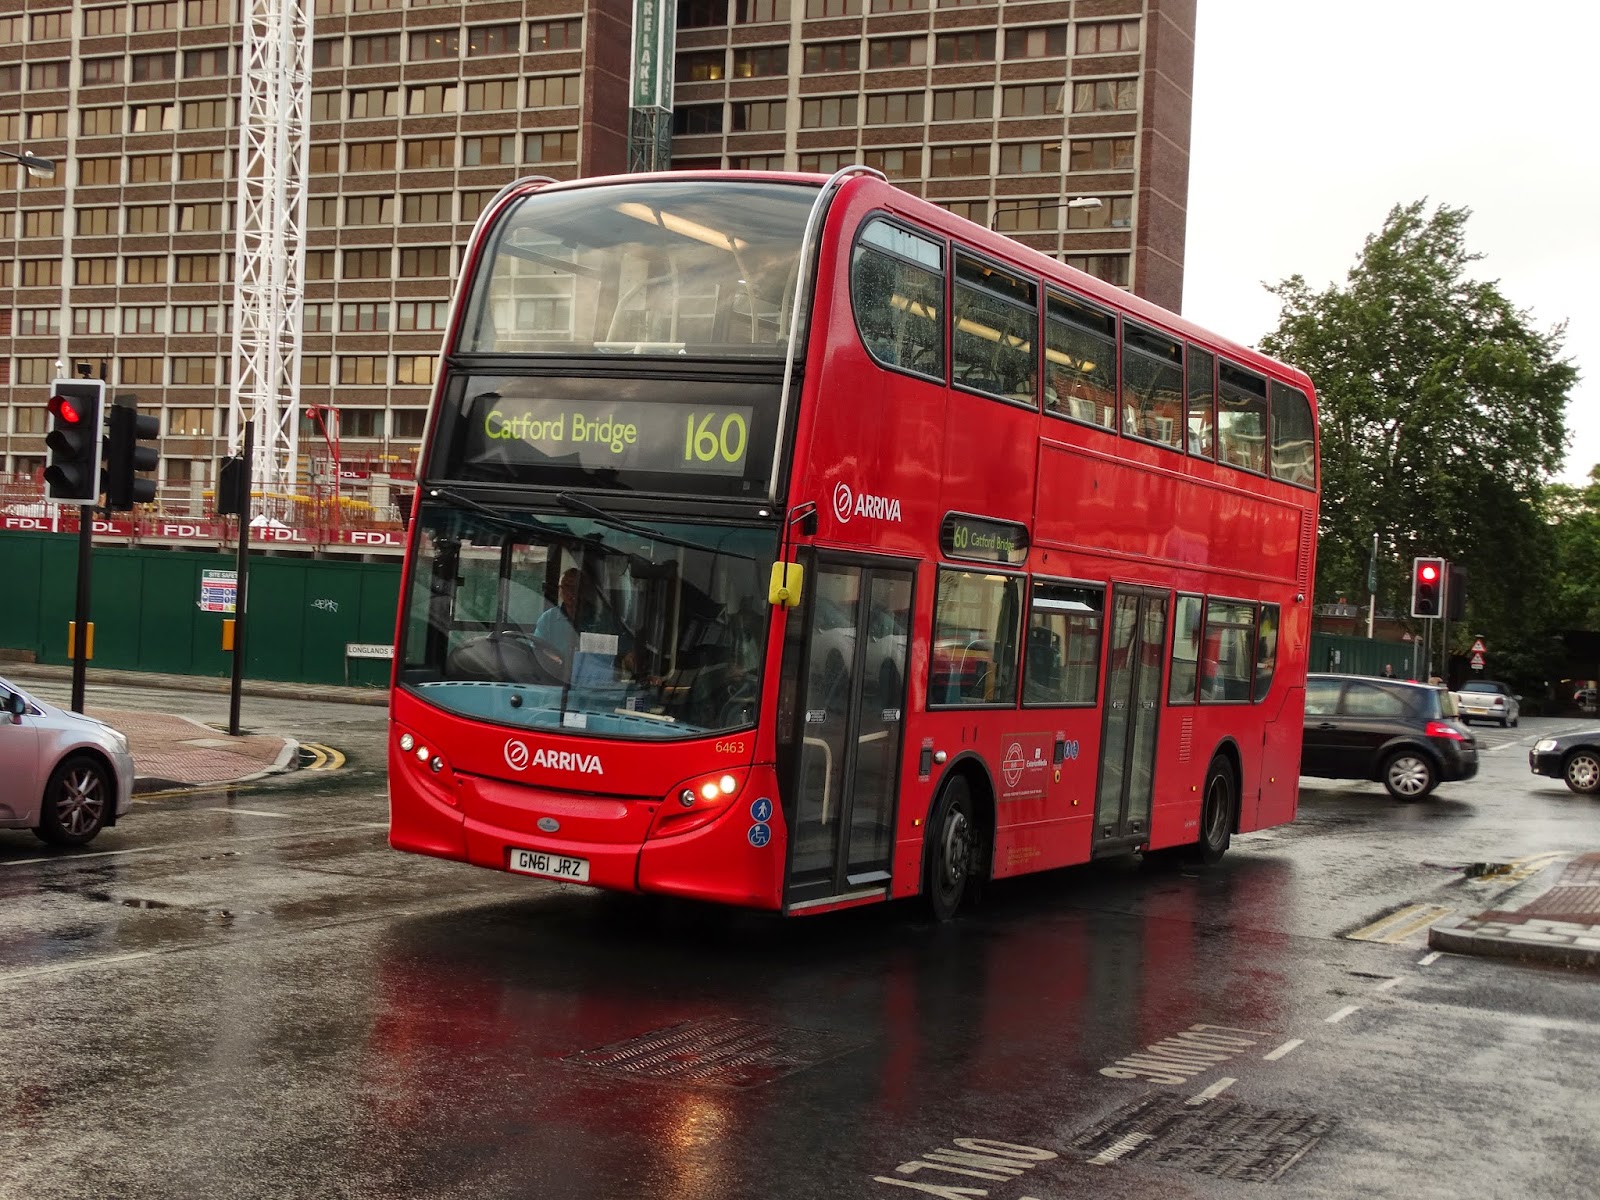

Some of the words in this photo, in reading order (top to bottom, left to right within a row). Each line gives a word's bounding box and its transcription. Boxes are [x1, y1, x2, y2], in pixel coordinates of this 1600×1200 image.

[485, 410, 564, 441] Catford
[571, 413, 637, 454] Bridge
[684, 412, 747, 463] 160
[854, 493, 901, 521] ARRIVA
[6, 518, 48, 529] FDL
[163, 524, 209, 538] FDL
[259, 528, 307, 541] FDL
[351, 532, 400, 545] FDL
[954, 526, 968, 549] 60
[971, 532, 996, 549] Catford
[996, 535, 1015, 556] Bridge
[348, 646, 389, 655] LONGLANDS
[715, 741, 745, 754] 6463
[532, 748, 604, 775] ARRIVA
[519, 852, 551, 873] GN61
[553, 858, 582, 877] JRZ
[873, 1137, 1058, 1200] ONLY
